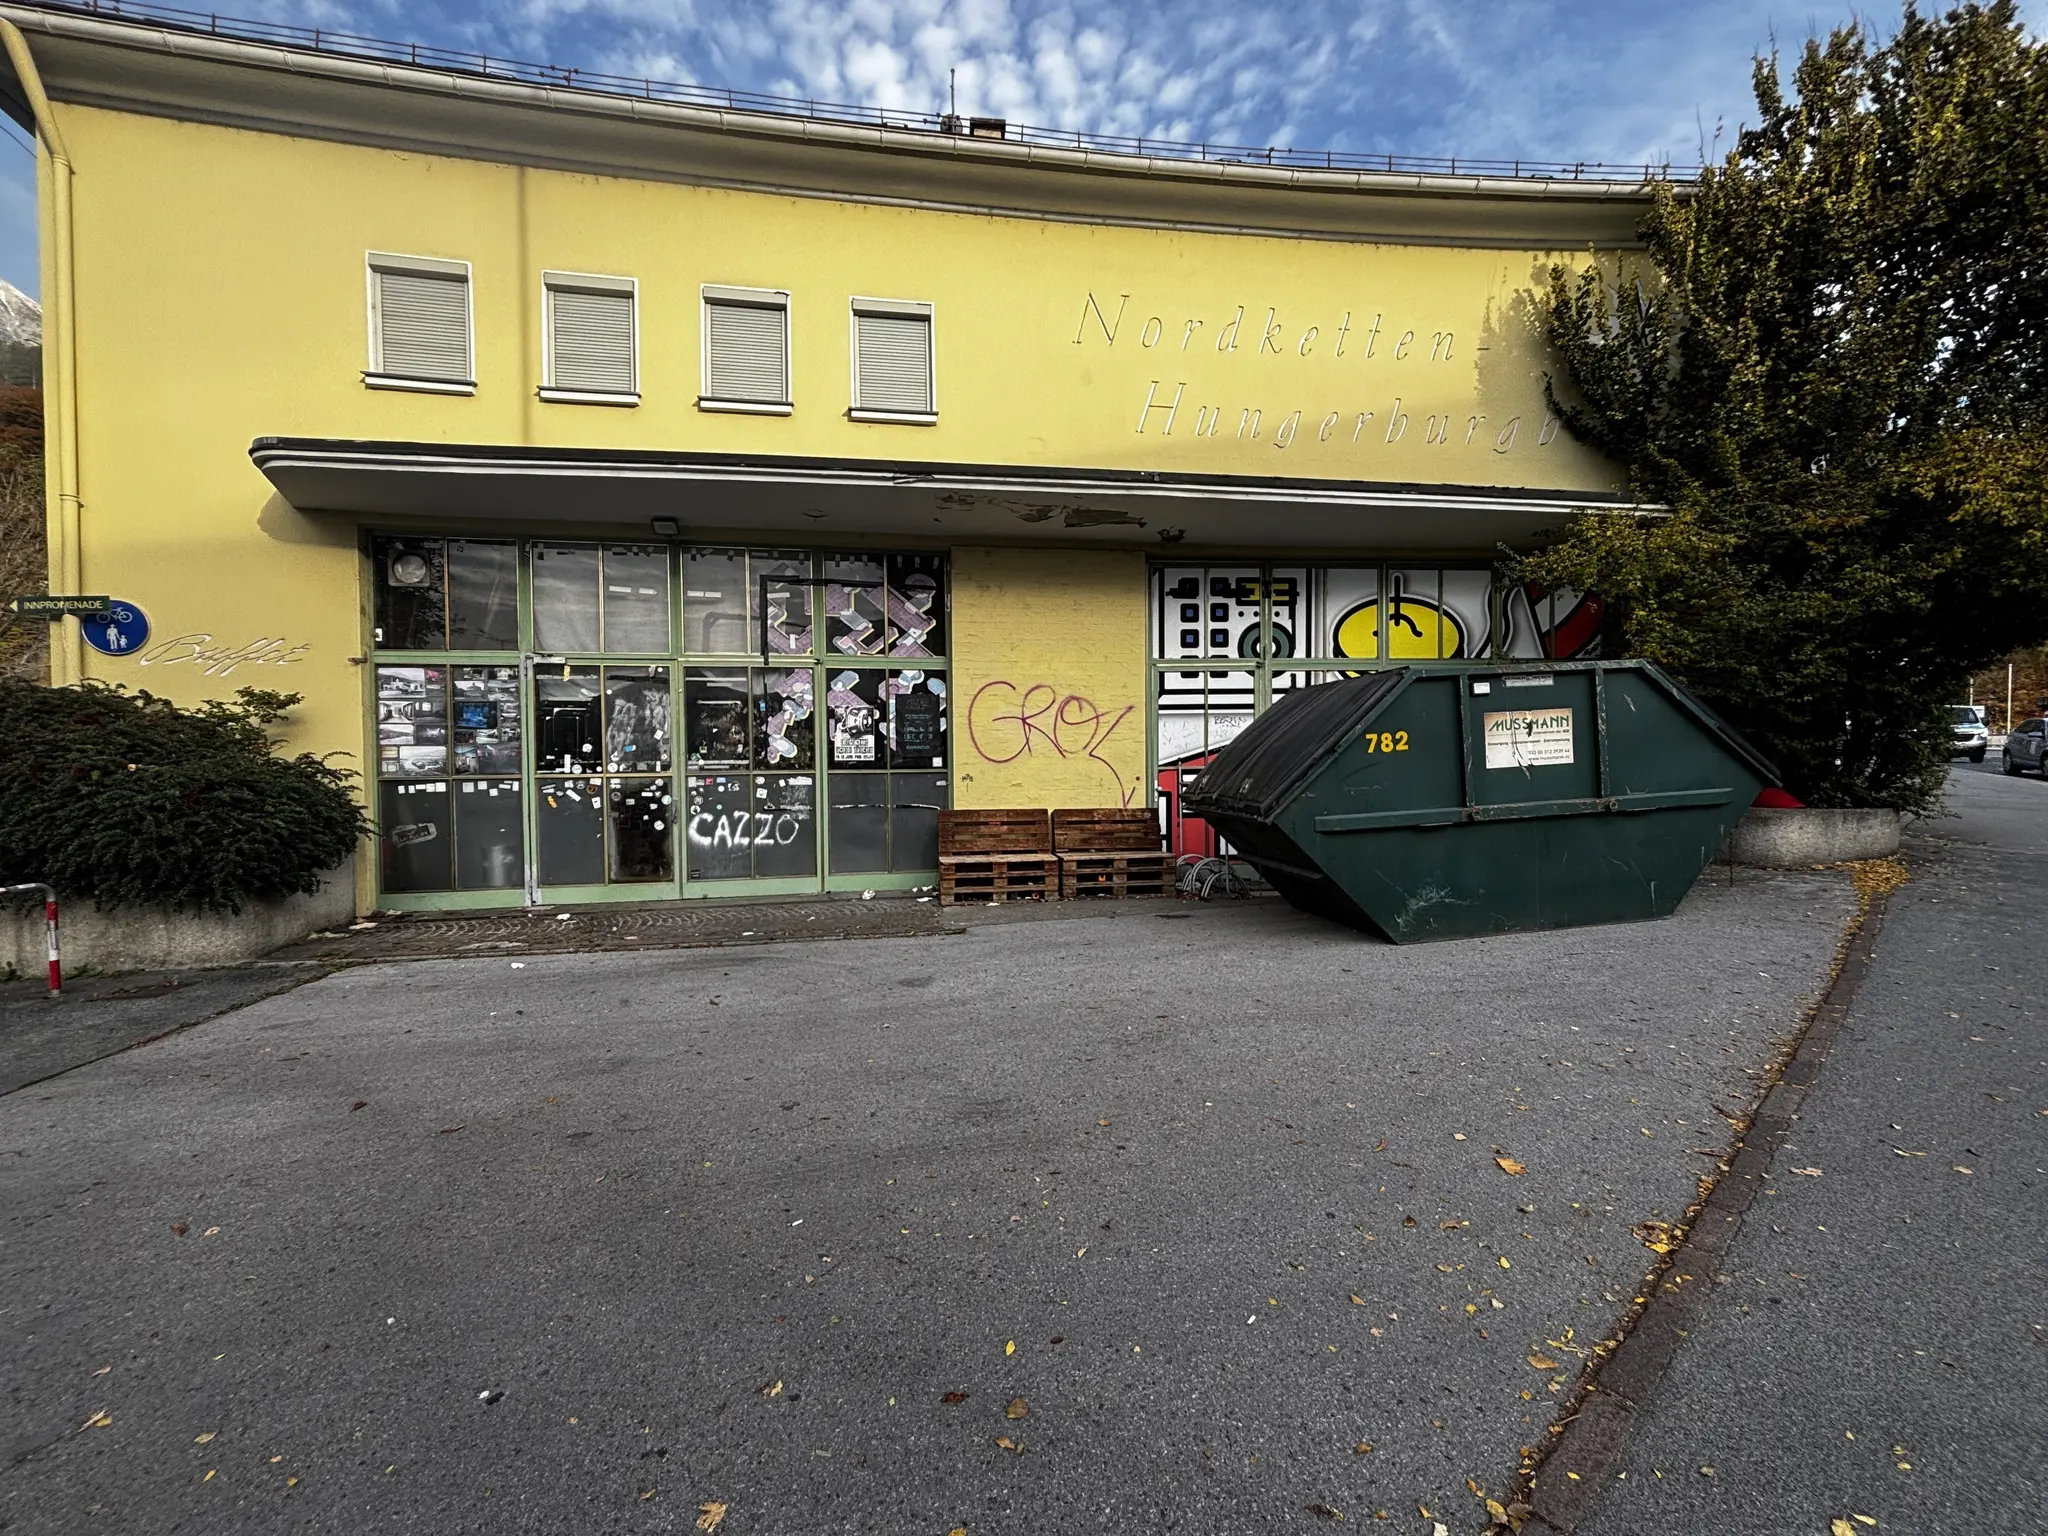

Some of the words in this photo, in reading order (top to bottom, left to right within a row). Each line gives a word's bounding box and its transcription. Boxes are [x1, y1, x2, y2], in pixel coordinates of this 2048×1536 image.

[23, 600, 104, 610] INNPROMENADE
[139, 633, 312, 678] Buffet
[1488, 714, 1570, 732] MUSSMANN
[1365, 730, 1409, 753] 782
[688, 810, 799, 848] CAZZO
